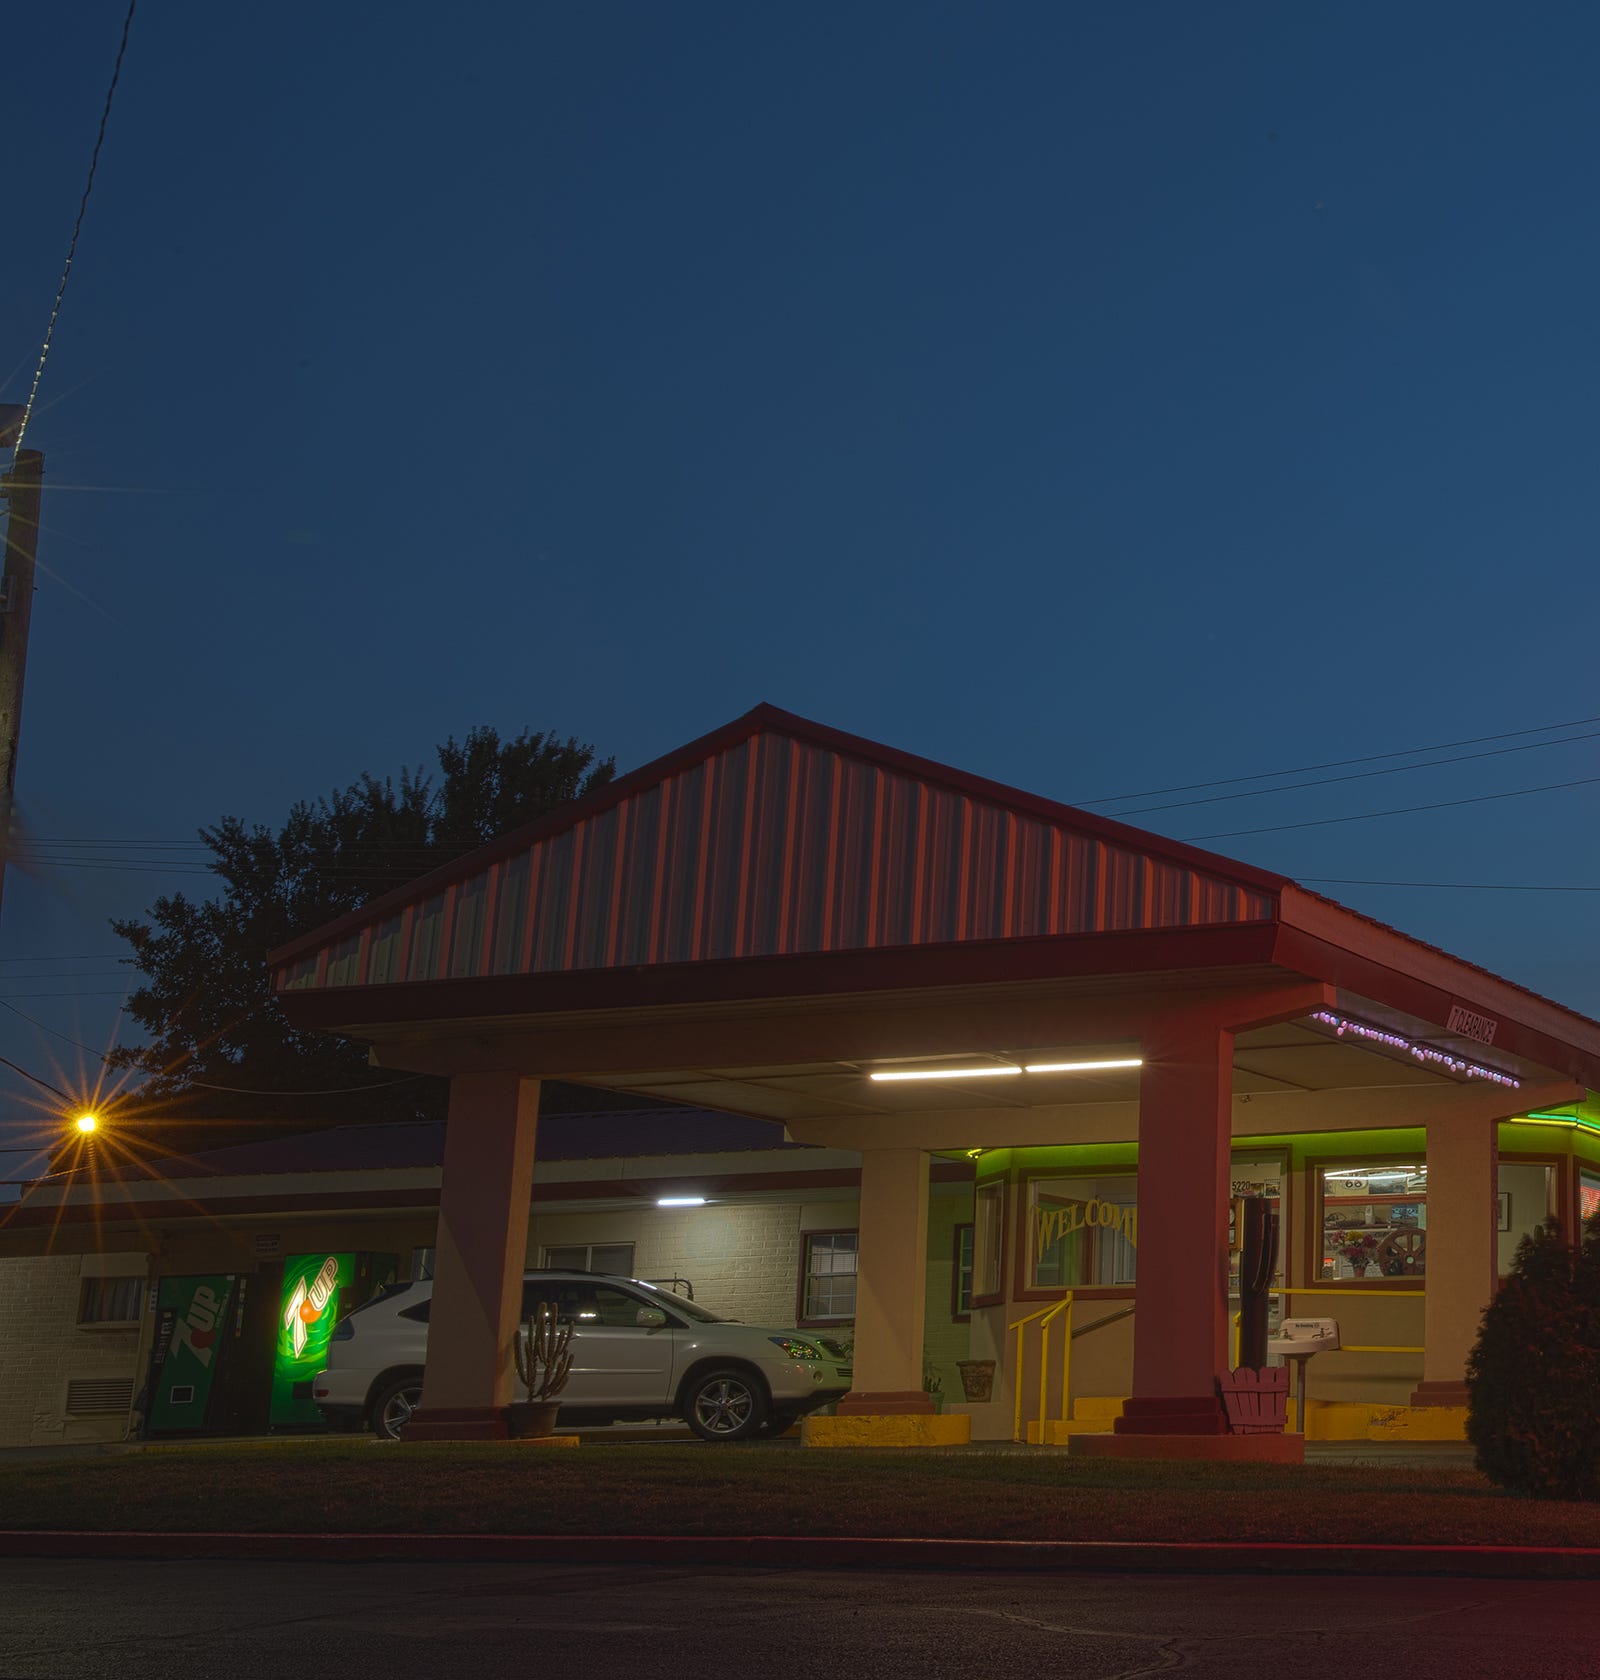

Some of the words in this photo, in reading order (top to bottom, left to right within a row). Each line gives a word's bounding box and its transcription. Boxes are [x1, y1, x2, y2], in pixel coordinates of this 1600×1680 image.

[1033, 1198, 1137, 1264] WELCOM
[169, 1285, 224, 1369] 7UP
[284, 1256, 339, 1360] 7UP
